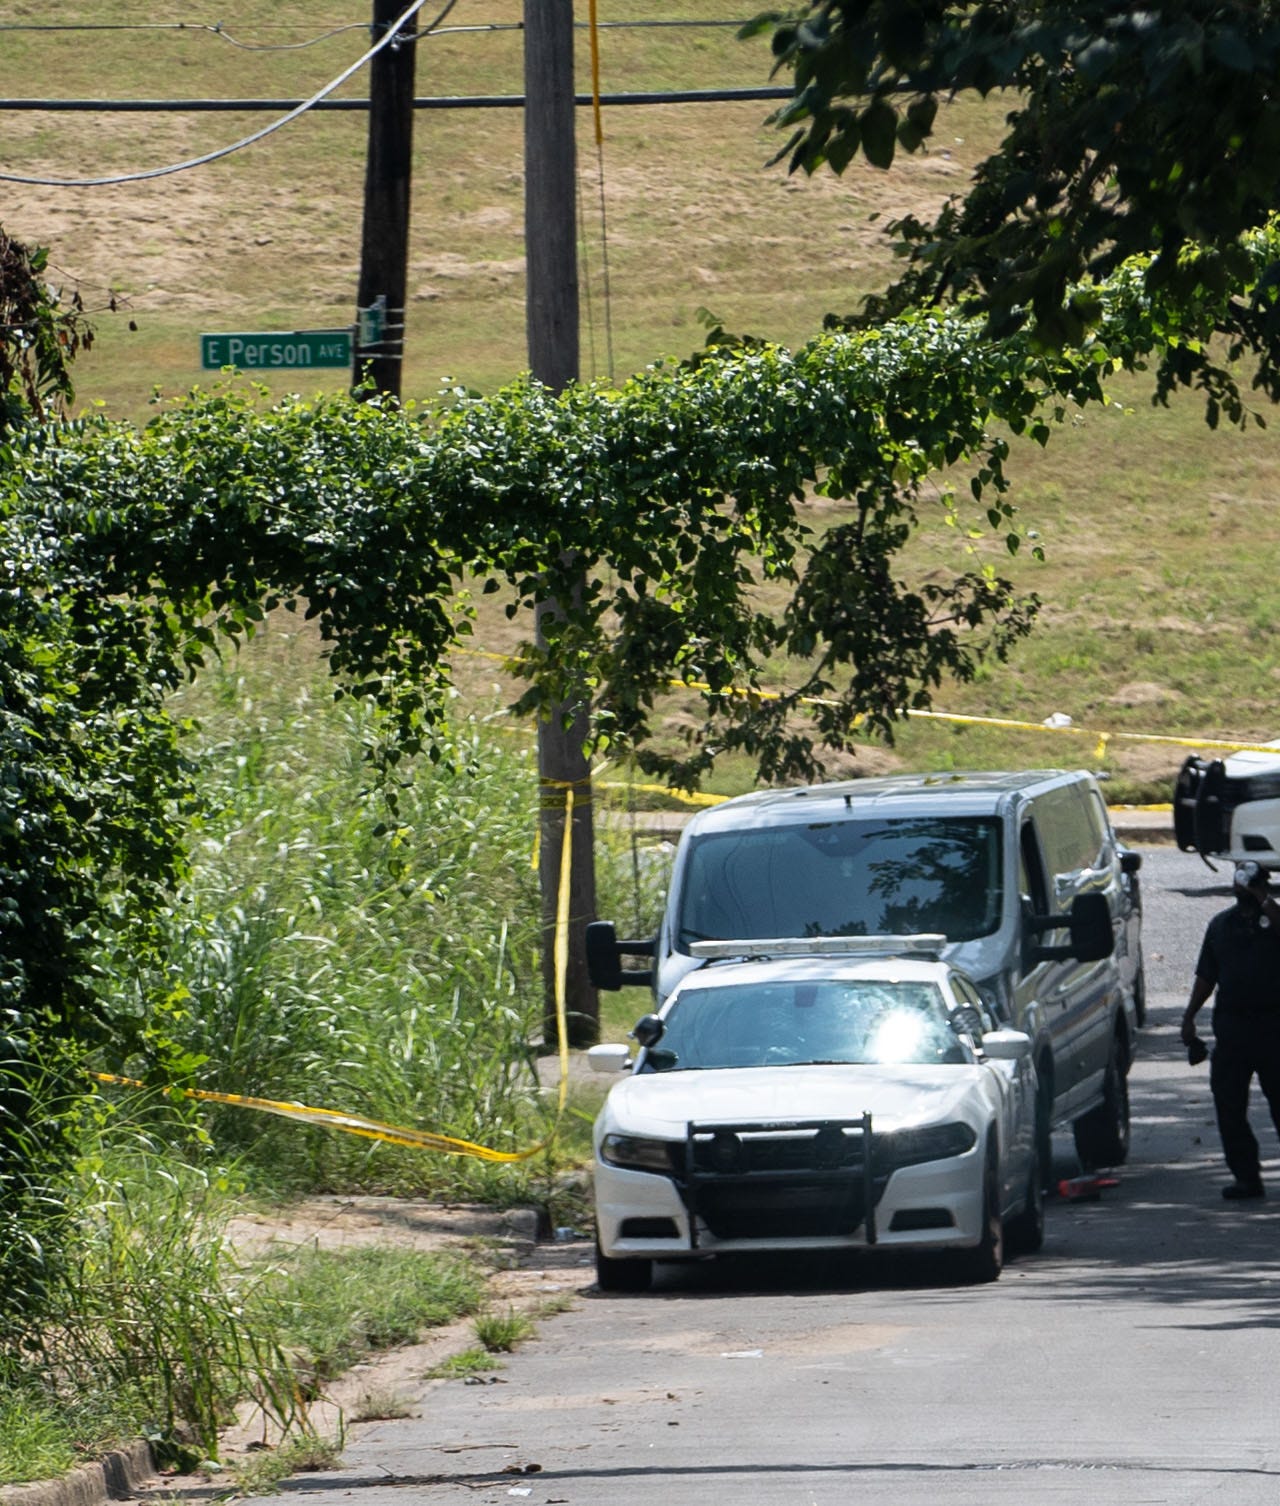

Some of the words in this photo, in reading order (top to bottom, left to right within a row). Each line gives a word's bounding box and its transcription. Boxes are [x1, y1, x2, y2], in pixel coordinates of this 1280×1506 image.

[208, 341, 221, 364] E
[228, 338, 312, 365] Person
[319, 343, 345, 358] AVE
